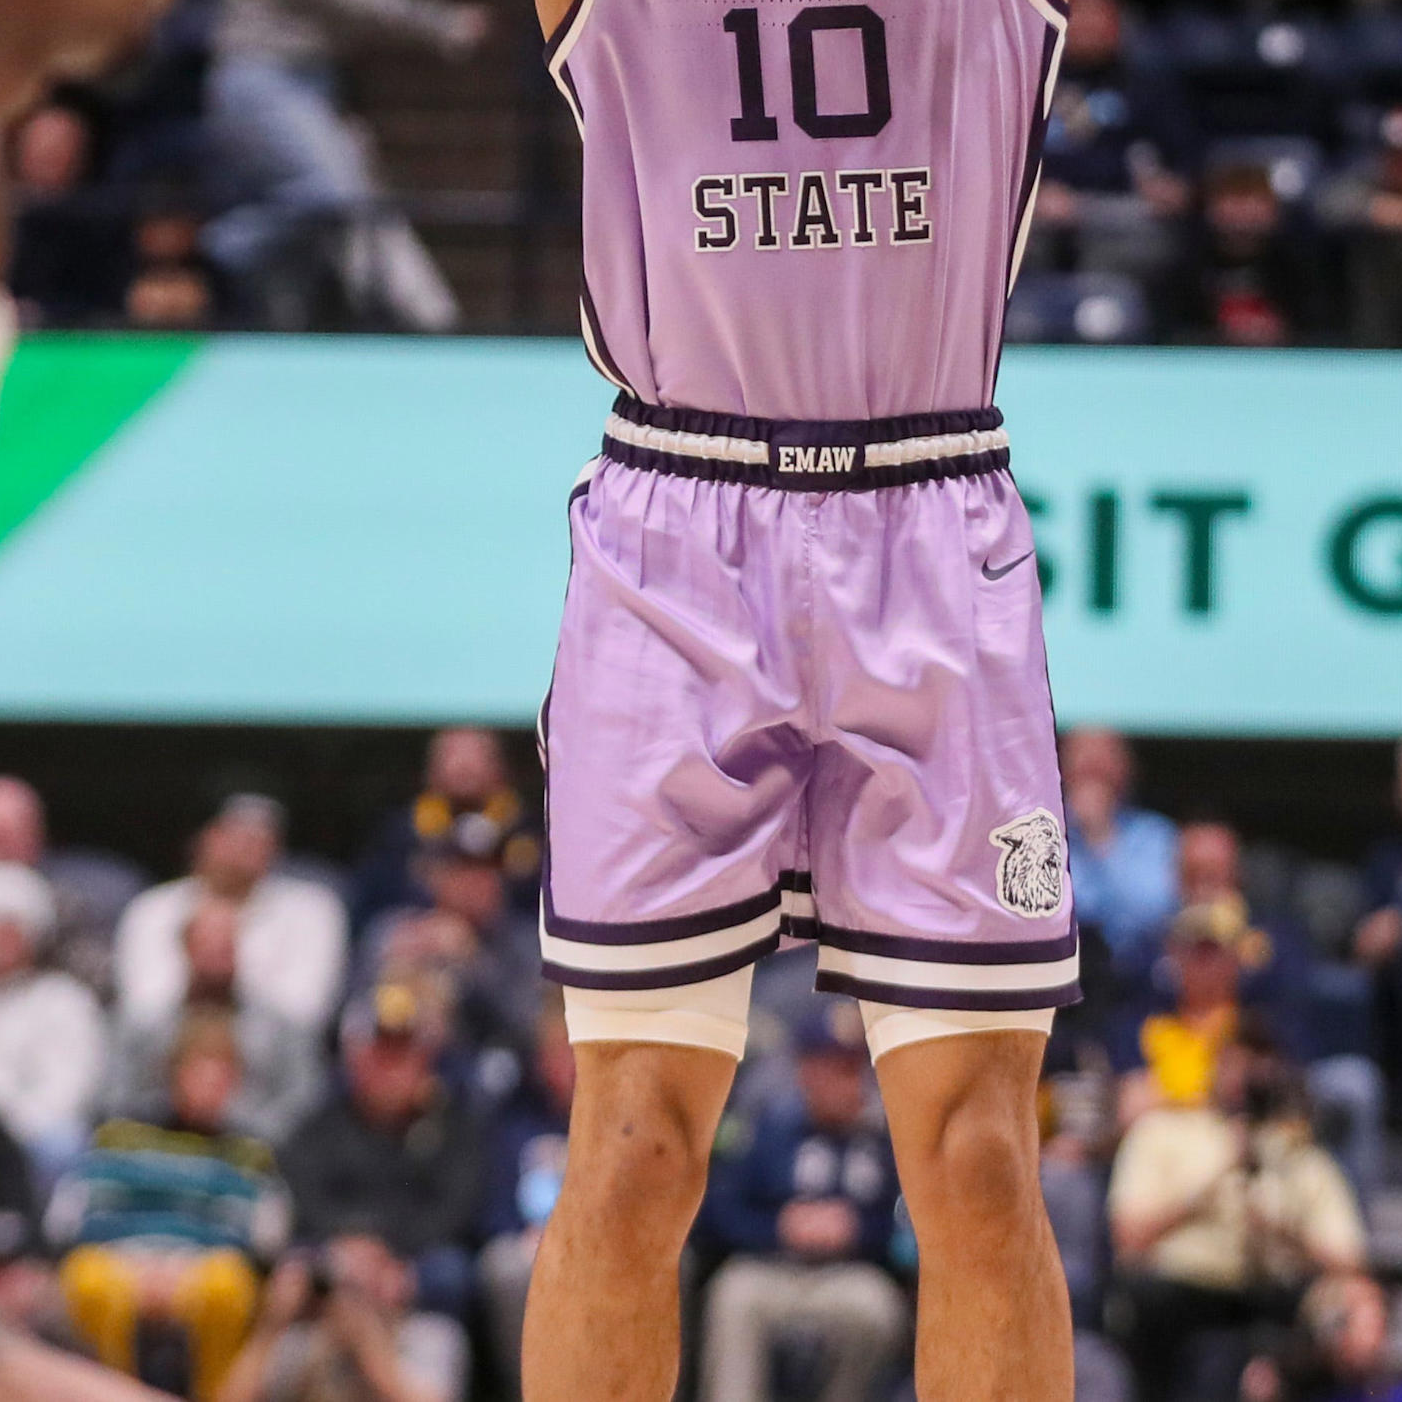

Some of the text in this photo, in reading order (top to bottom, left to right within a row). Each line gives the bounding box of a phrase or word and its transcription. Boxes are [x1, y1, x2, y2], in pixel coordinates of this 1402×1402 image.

[722, 3, 894, 142] 10
[691, 168, 933, 252] STATE
[778, 446, 857, 473] EMAW
